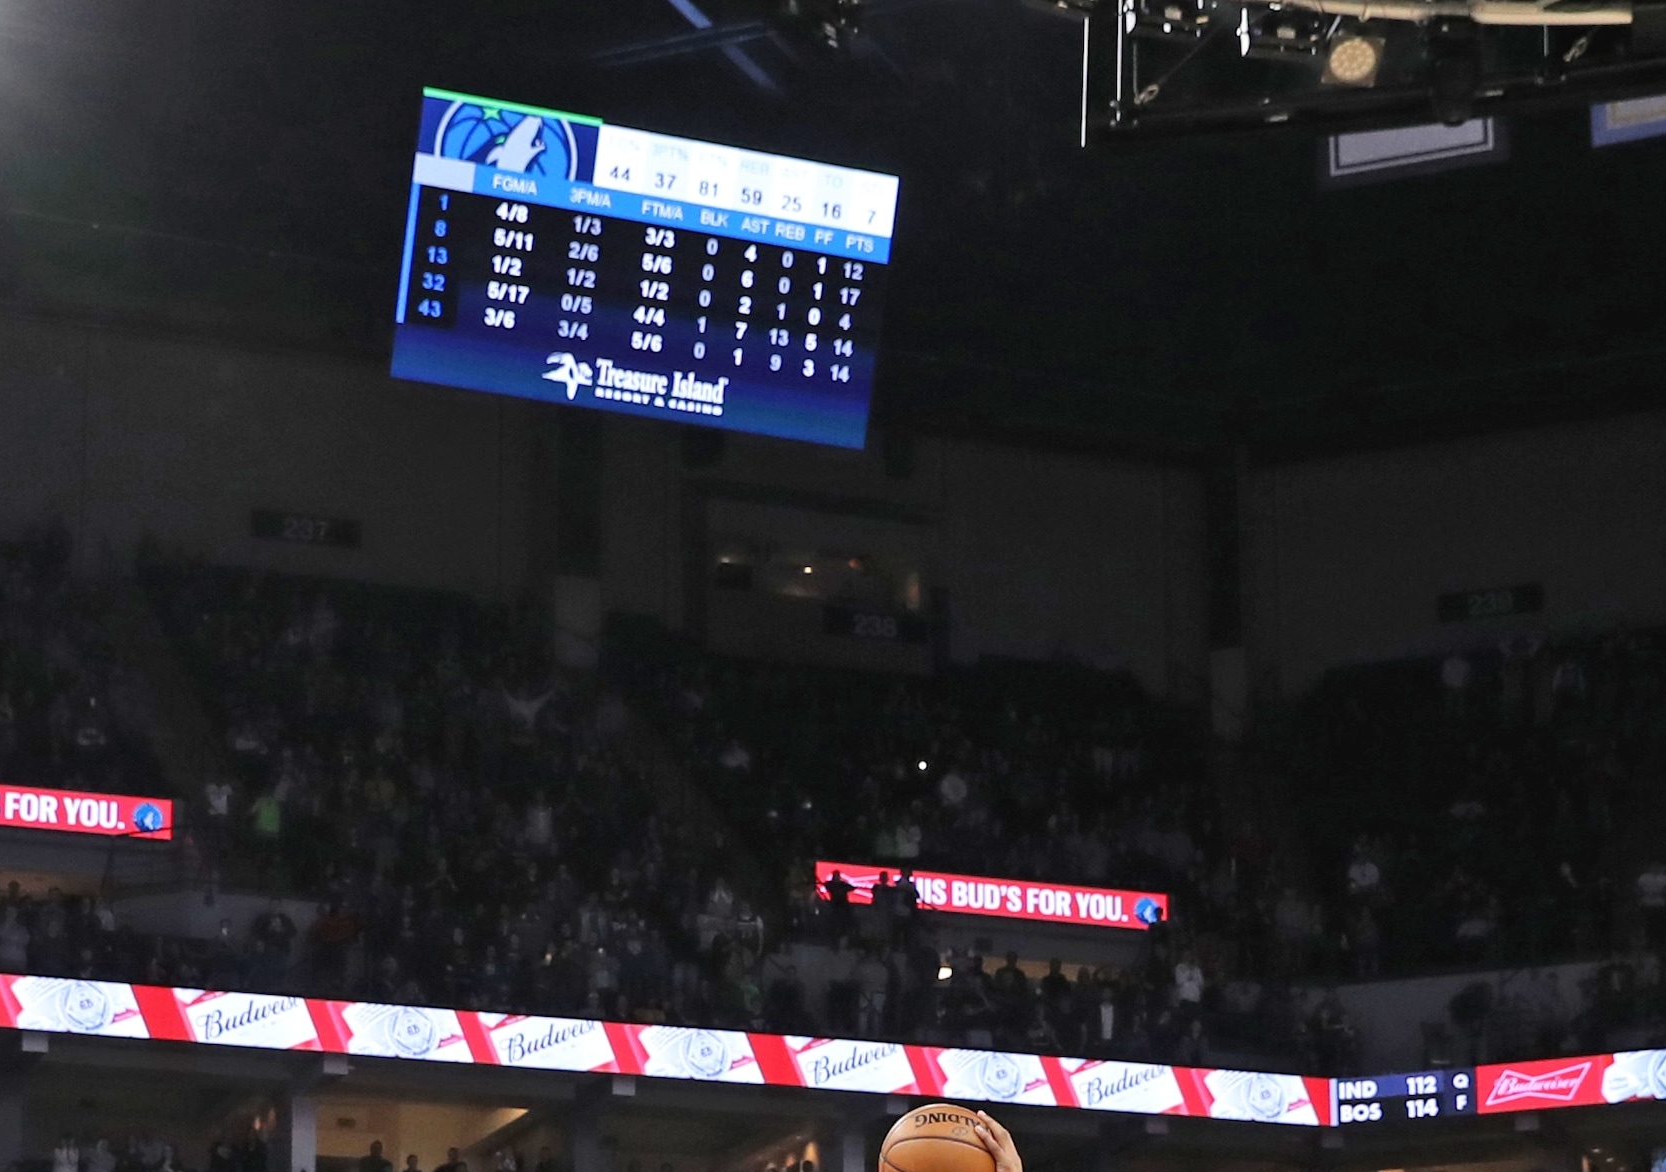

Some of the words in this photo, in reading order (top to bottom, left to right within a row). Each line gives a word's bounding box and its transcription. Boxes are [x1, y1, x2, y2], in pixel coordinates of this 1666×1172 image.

[492, 173, 538, 196] FGM/A
[569, 187, 612, 209] 3PM/A
[641, 200, 684, 221] FTM/A
[700, 210, 729, 229] BLK
[740, 217, 770, 235] AST
[775, 224, 806, 242] REB
[814, 229, 834, 246] PF
[845, 234, 875, 254] PTS
[609, 165, 631, 182] 44
[654, 172, 676, 190] 37
[699, 180, 719, 198] 81
[741, 187, 762, 206] 59
[781, 195, 803, 213] 25
[822, 203, 842, 220] 16
[866, 210, 877, 226] 7
[439, 193, 449, 211] 1
[495, 201, 529, 224] 4/8
[573, 215, 603, 236] 1/3
[644, 226, 675, 248] 3/3
[706, 238, 719, 256] 0
[743, 244, 758, 263] 4
[781, 250, 794, 269] 0
[816, 256, 827, 275] 1
[843, 261, 864, 281] 12
[493, 227, 534, 252] 5/11
[567, 241, 600, 262] 2/6
[641, 253, 673, 275] 5/6
[701, 263, 715, 282] 0
[740, 269, 754, 289] 6
[778, 276, 791, 295] 0
[813, 281, 823, 300] 1
[840, 287, 861, 307] 17
[421, 271, 445, 292] 32
[486, 280, 530, 305] 5/17
[560, 293, 593, 315] 0/5
[632, 304, 666, 327] 4/4
[697, 315, 707, 334] 1
[735, 321, 748, 340] 7
[769, 327, 789, 347] 13
[804, 332, 818, 352] 5
[833, 338, 854, 358] 14
[426, 245, 449, 265] 13
[491, 254, 523, 277] 1/2
[566, 267, 597, 289] 1/2
[640, 279, 670, 301] 1/2
[698, 289, 711, 308] 0
[738, 295, 752, 315] 2
[776, 302, 786, 320] 1
[807, 307, 821, 326] 0
[838, 313, 852, 331] 4
[417, 298, 442, 318] 43
[483, 307, 516, 329] 3/6
[557, 320, 589, 341] 3/4
[631, 331, 663, 353] 5/6
[693, 342, 706, 360] 0
[733, 348, 743, 366] 1
[769, 354, 782, 372] 9
[802, 358, 815, 378] 3
[829, 363, 851, 383] 14
[595, 357, 669, 395] Treasure
[671, 371, 725, 404] Island
[4, 789, 59, 827] FOR
[63, 796, 127, 831] YOU.
[951, 879, 1023, 915] BUD'S
[1026, 887, 1073, 918] FOR
[1076, 891, 1129, 923] YOU.
[1338, 1077, 1378, 1101] IND
[1405, 1074, 1438, 1096] 112
[1452, 1071, 1469, 1091] Q
[1338, 1101, 1382, 1124] BOS
[1405, 1098, 1439, 1119] 114
[1455, 1095, 1468, 1112] F
[1490, 1070, 1581, 1099] Budweiser
